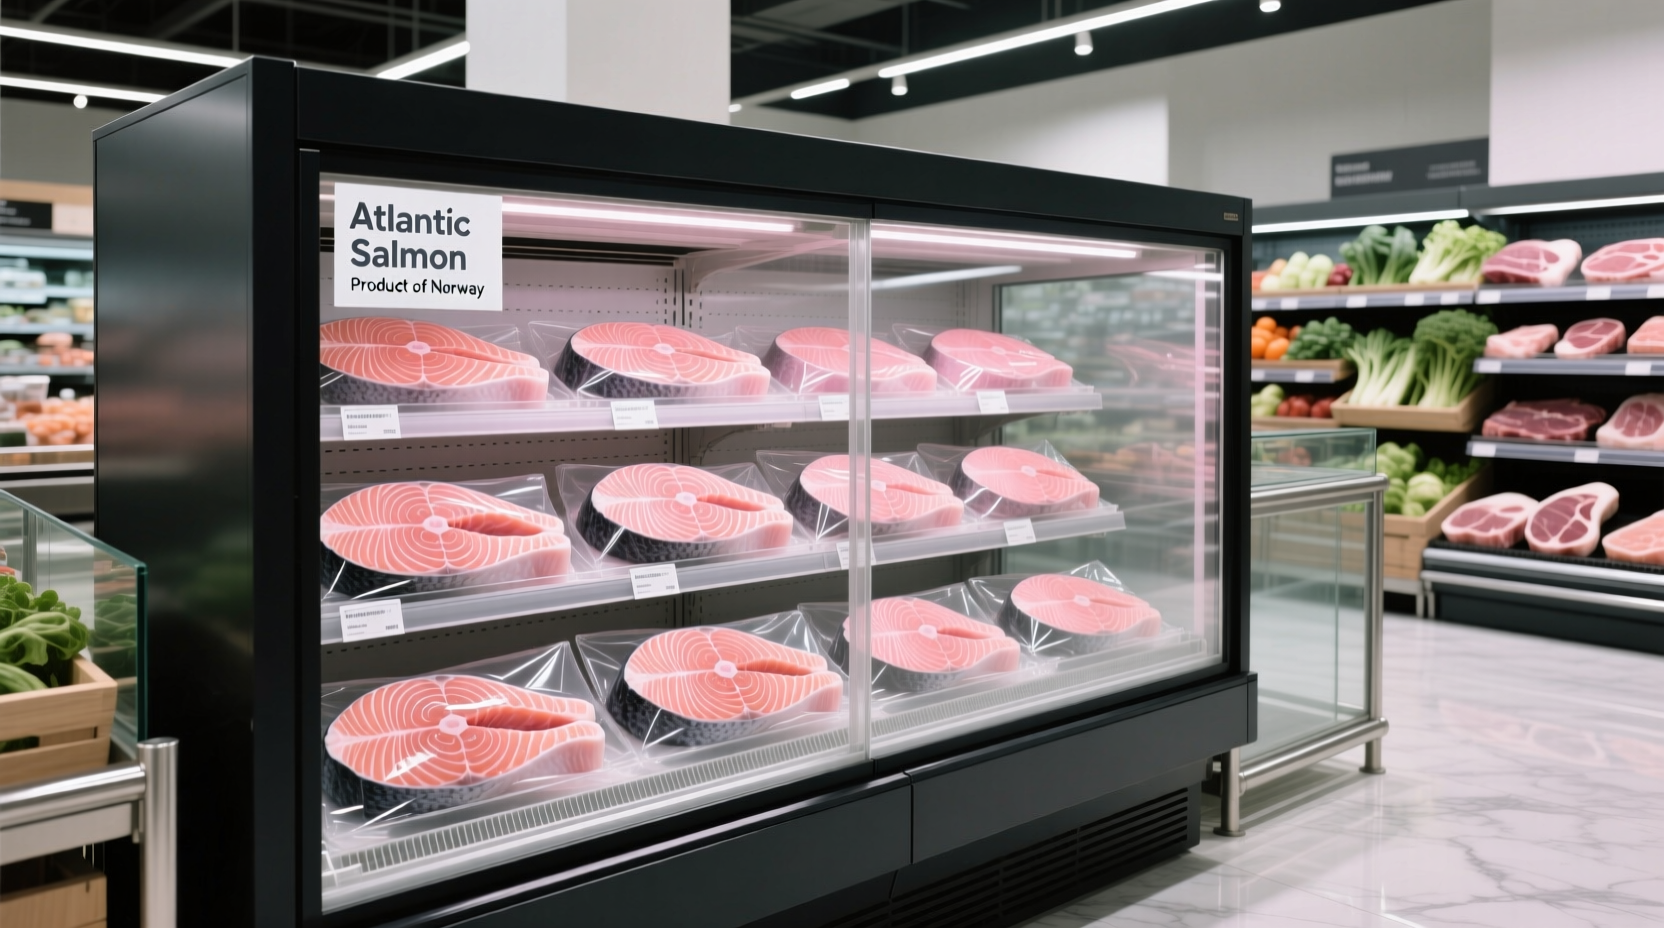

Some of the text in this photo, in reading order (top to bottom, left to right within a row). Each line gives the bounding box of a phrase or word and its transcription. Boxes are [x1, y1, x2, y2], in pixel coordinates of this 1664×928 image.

[349, 201, 471, 237] Atlantic
[350, 238, 467, 271] Salmon
[351, 277, 485, 299] Product of Norway
